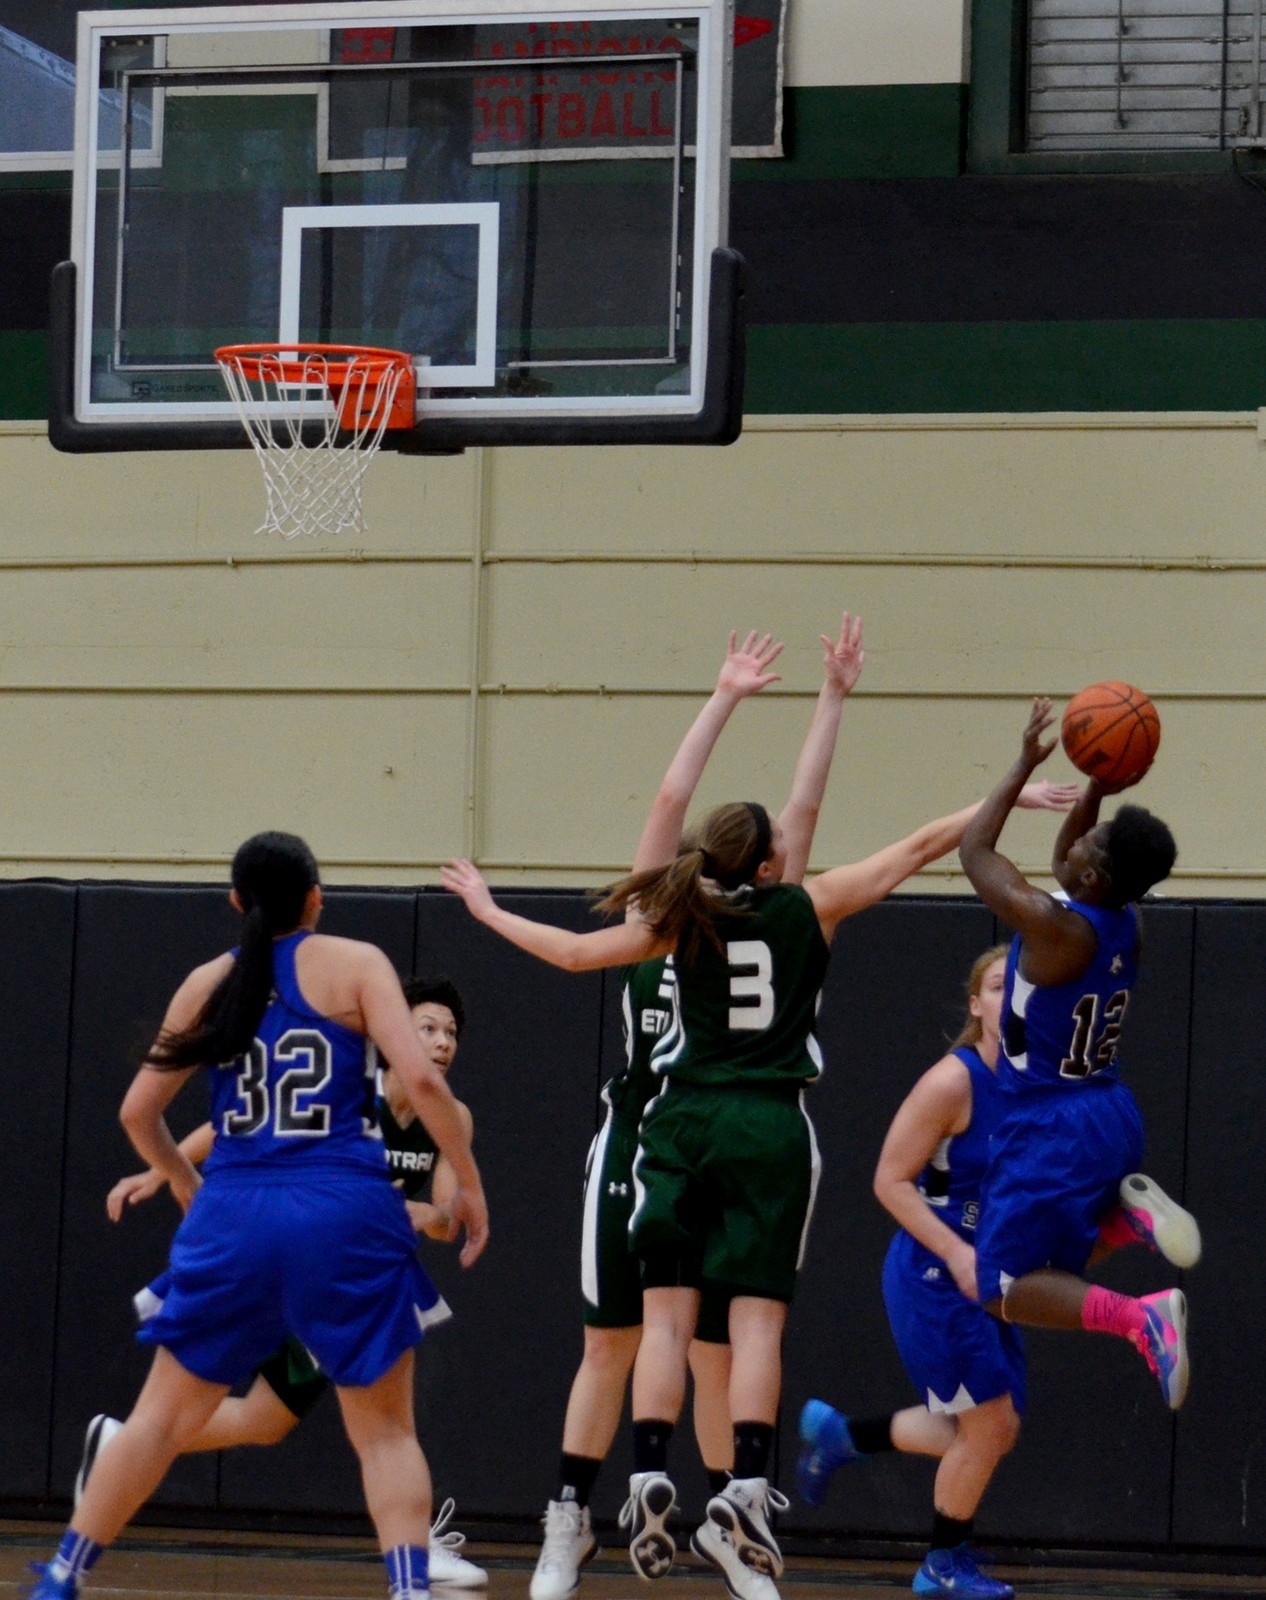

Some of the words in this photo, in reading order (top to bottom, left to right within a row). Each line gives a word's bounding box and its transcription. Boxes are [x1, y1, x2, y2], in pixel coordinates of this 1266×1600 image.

[727, 940, 775, 1030] 3
[1059, 989, 1129, 1080] 12
[218, 1028, 332, 1138] 32
